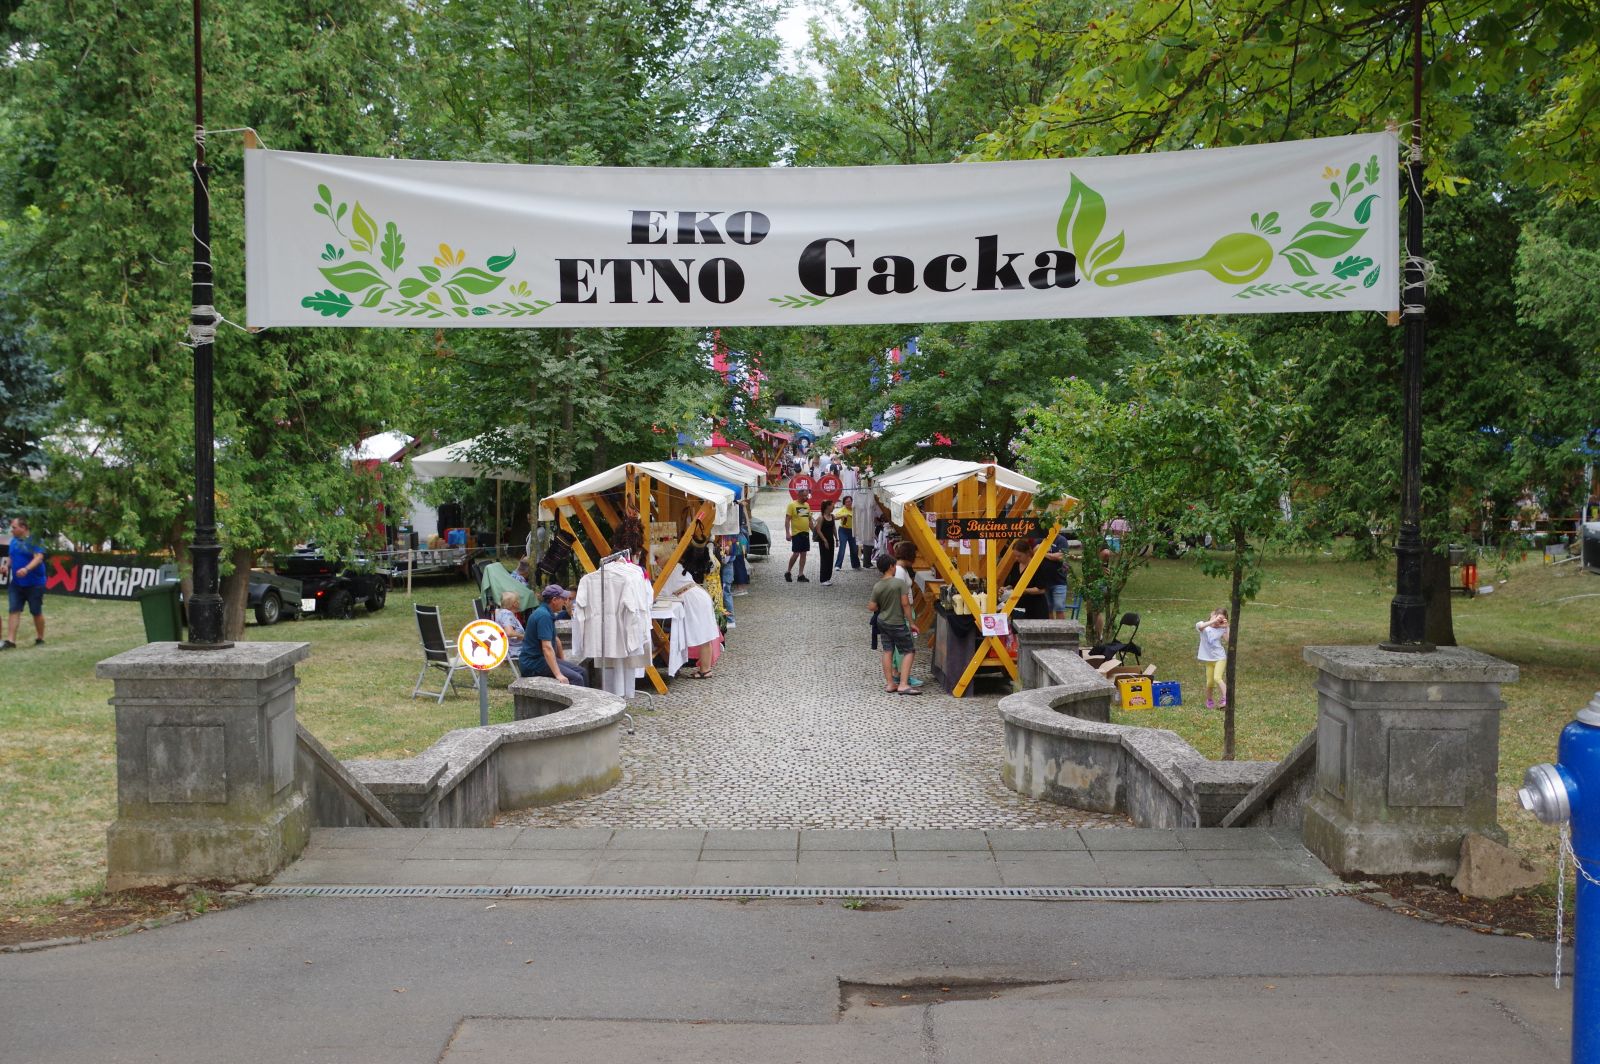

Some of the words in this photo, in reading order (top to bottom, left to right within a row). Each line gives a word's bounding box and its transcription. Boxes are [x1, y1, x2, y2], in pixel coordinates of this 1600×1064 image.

[627, 210, 771, 246] EKO
[554, 257, 746, 305] ETNO
[797, 234, 1081, 298] Gacka
[967, 520, 1008, 532] Bučino
[1011, 520, 1035, 534] ulje
